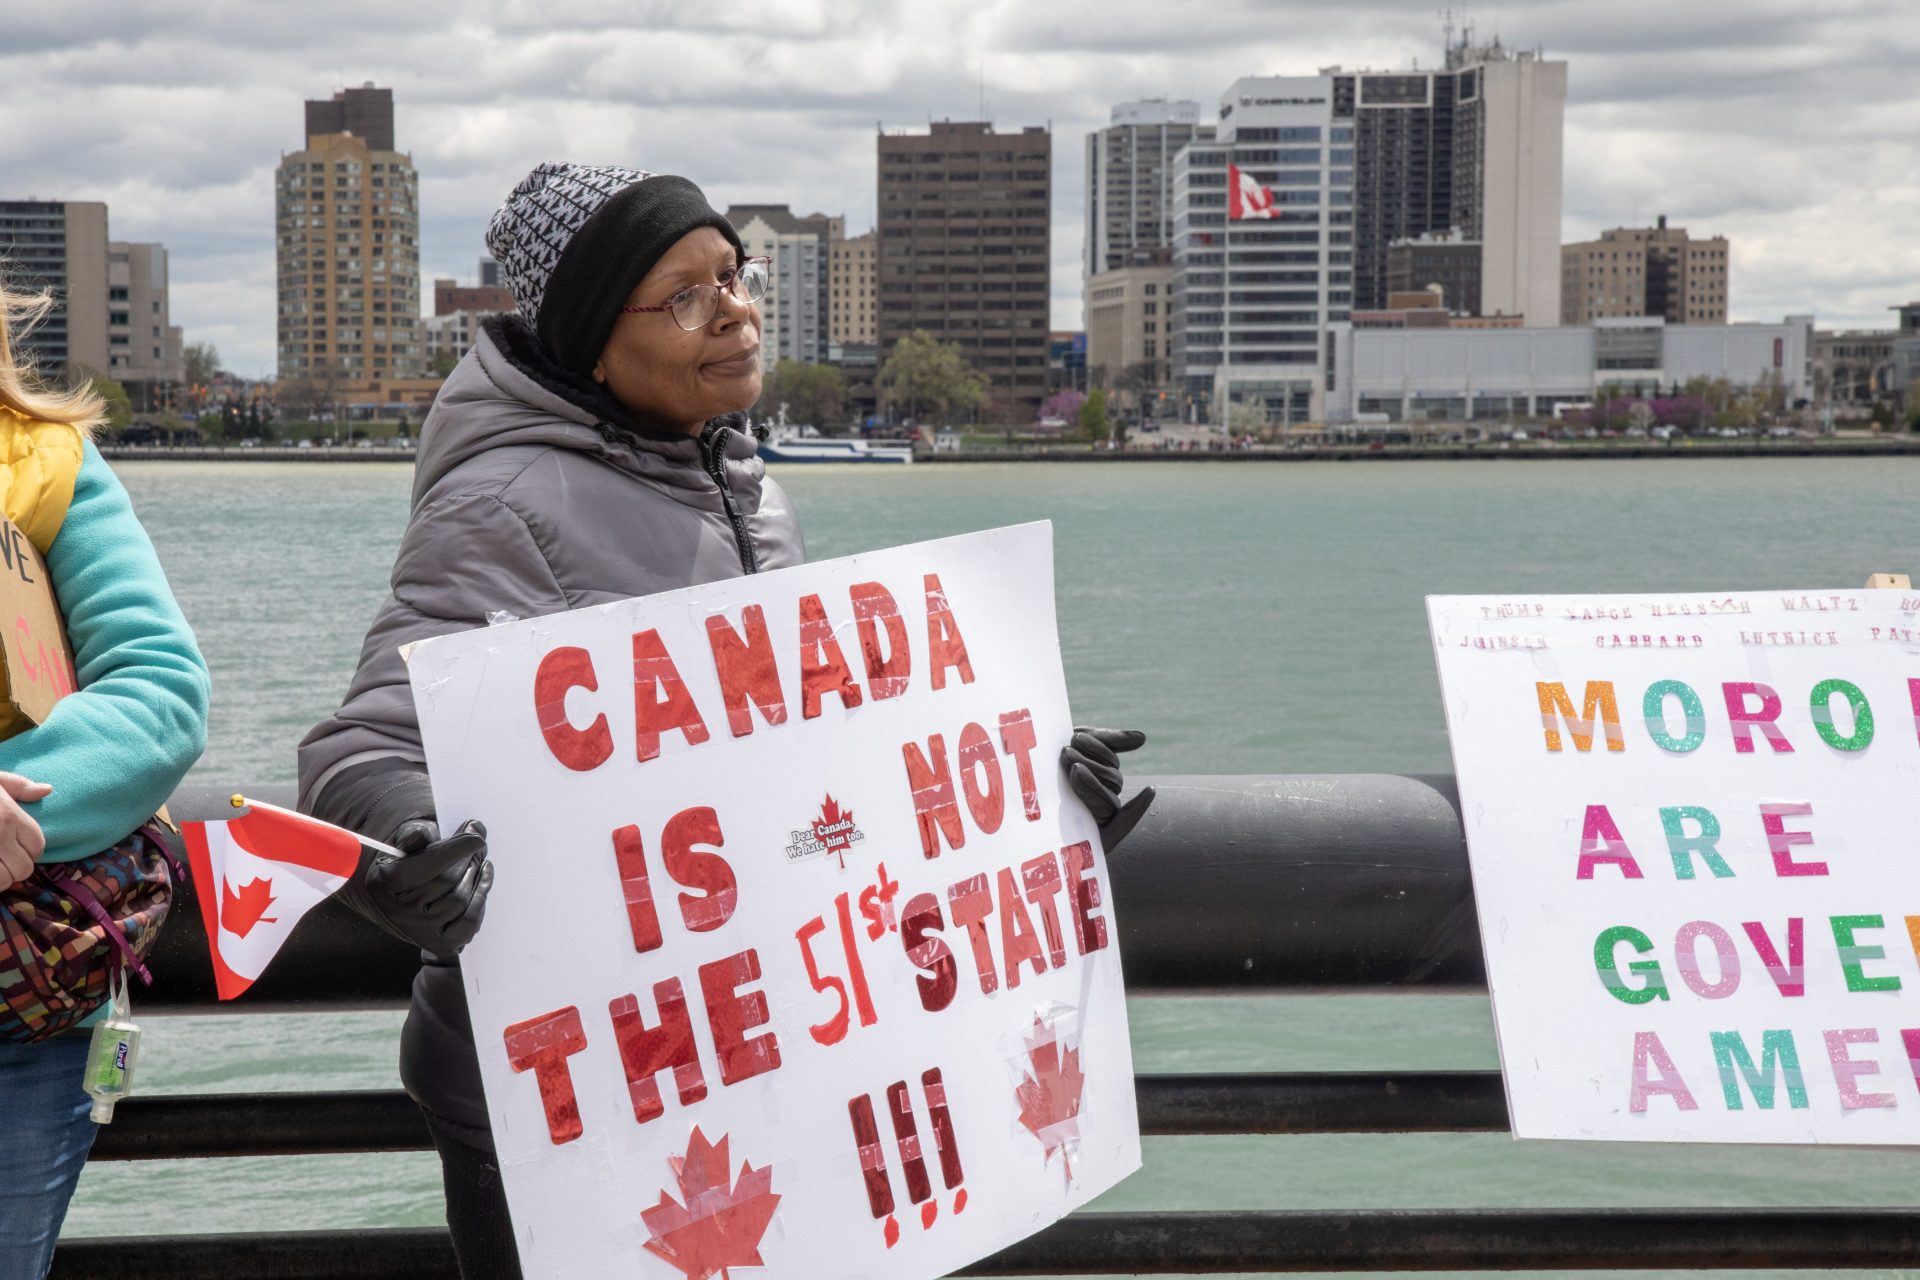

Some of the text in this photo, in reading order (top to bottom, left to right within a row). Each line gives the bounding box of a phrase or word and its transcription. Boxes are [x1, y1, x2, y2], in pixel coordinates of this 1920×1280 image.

[1480, 603, 1544, 620] TRUMP
[1781, 596, 1859, 611] WALTZ
[1596, 633, 1703, 649] GABBARD
[1739, 631, 1840, 646] LUTNICK
[1871, 627, 1920, 644] PAT
[535, 573, 976, 772] CANADA
[1535, 677, 1920, 753] MORO
[612, 707, 1041, 953] IS NOT
[786, 830, 864, 859] We hate him too.
[791, 818, 856, 844] Dear Canada,
[1576, 801, 1830, 880] ARE
[503, 948, 782, 1145] THE
[900, 839, 1108, 1013] STATE
[1593, 914, 1920, 1005] GOVE
[1629, 1027, 1920, 1112] AME
[848, 1066, 968, 1249] !!!
